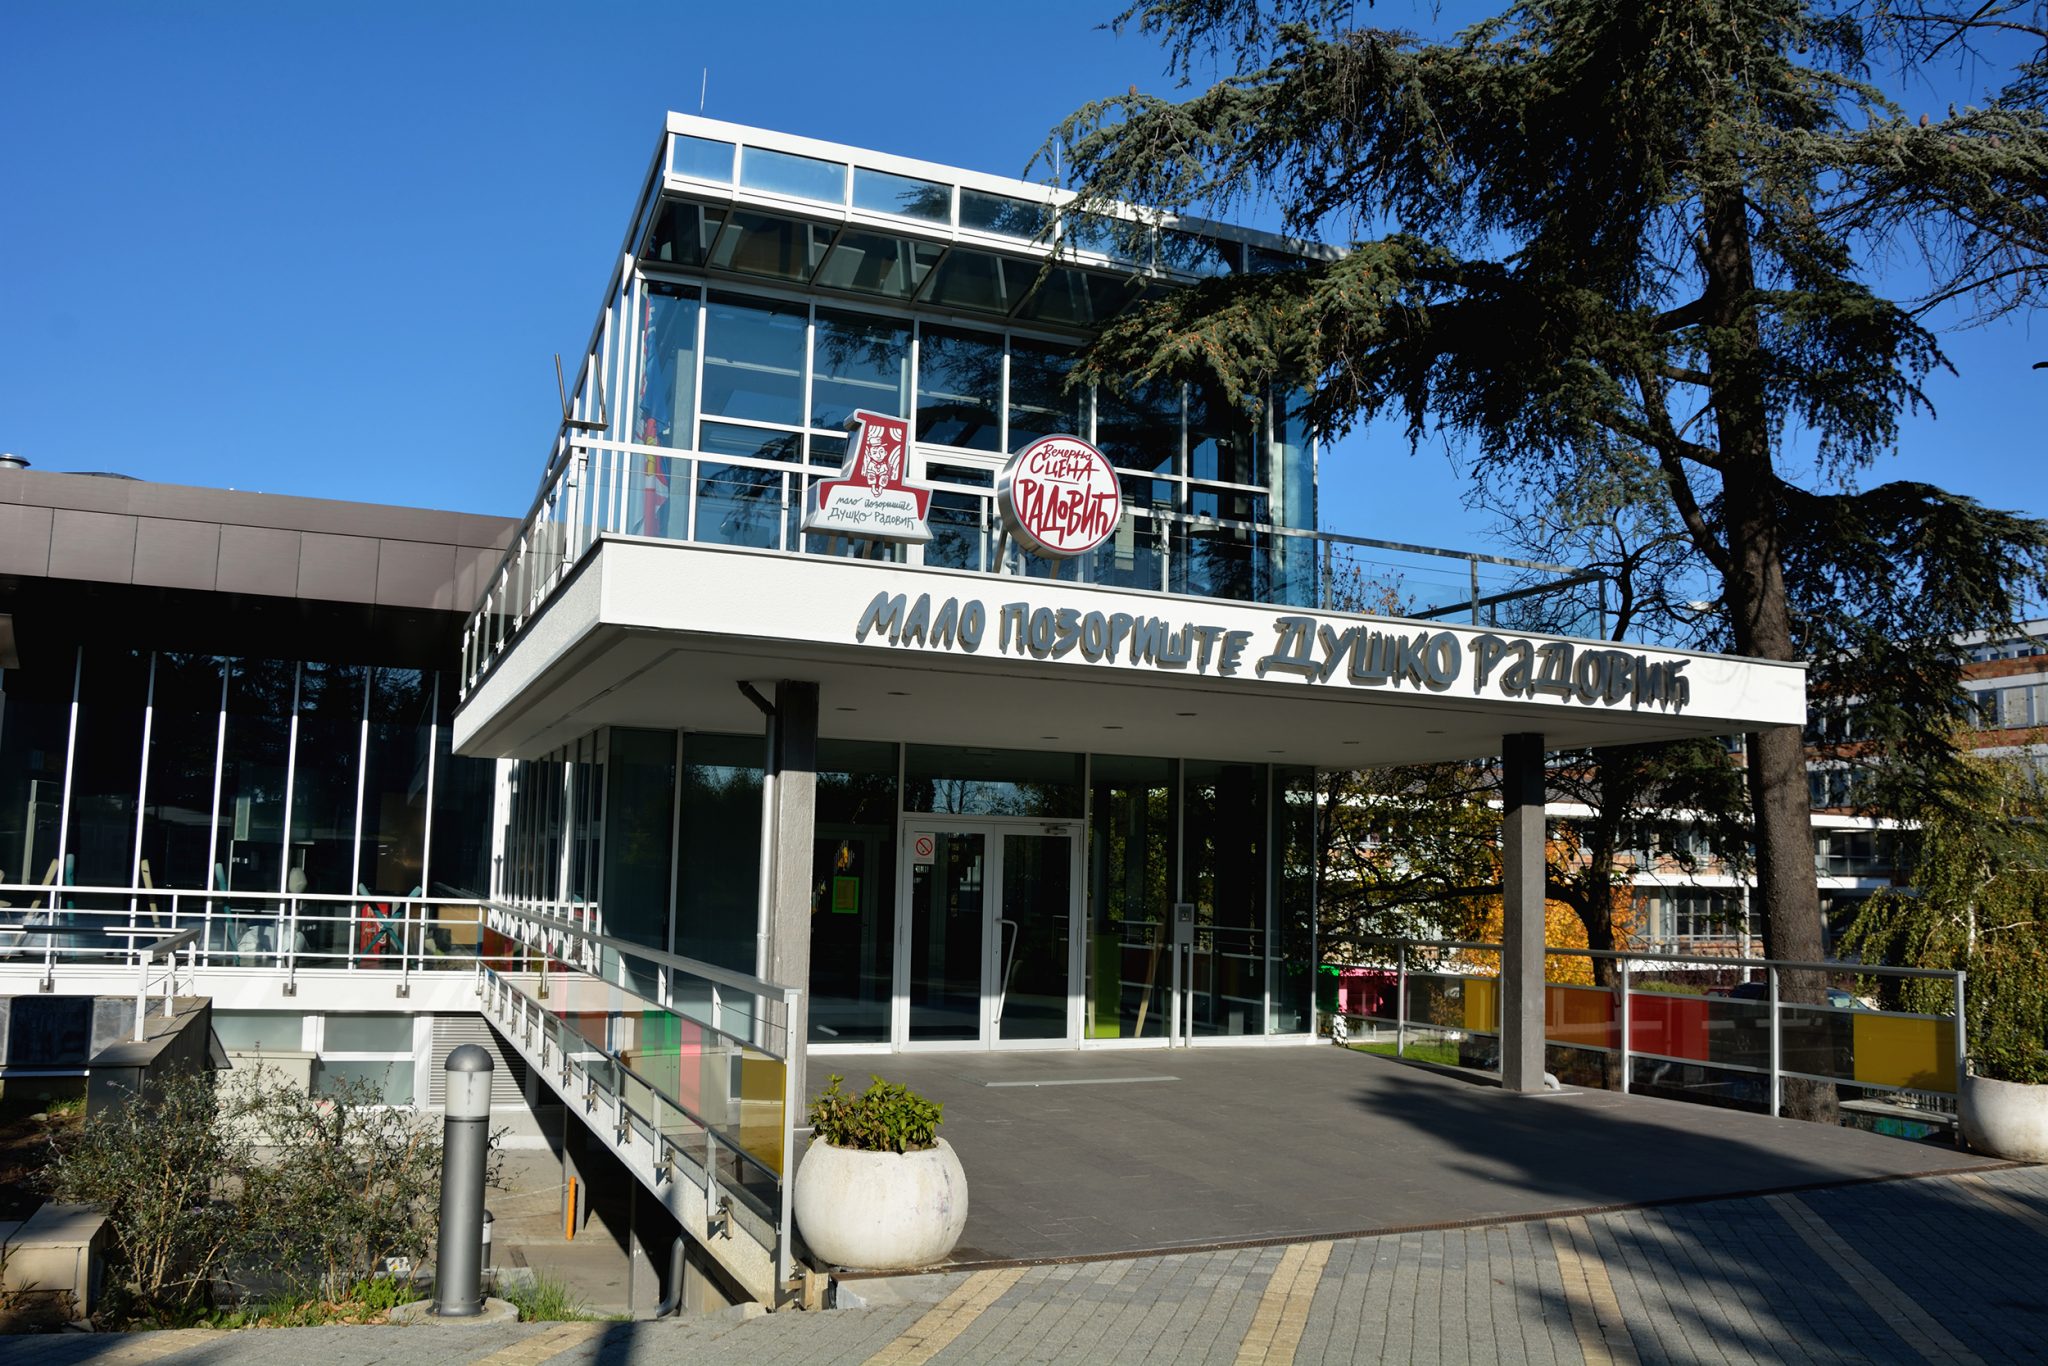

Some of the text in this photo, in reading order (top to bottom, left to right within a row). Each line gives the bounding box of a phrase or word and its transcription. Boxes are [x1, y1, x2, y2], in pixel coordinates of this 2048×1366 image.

[1030, 453, 1100, 481] СЦЕНА
[856, 591, 985, 652] МАЛО
[1000, 602, 1253, 676] ПОЗОРИШТЕ
[1255, 616, 1462, 692] ДУШКО
